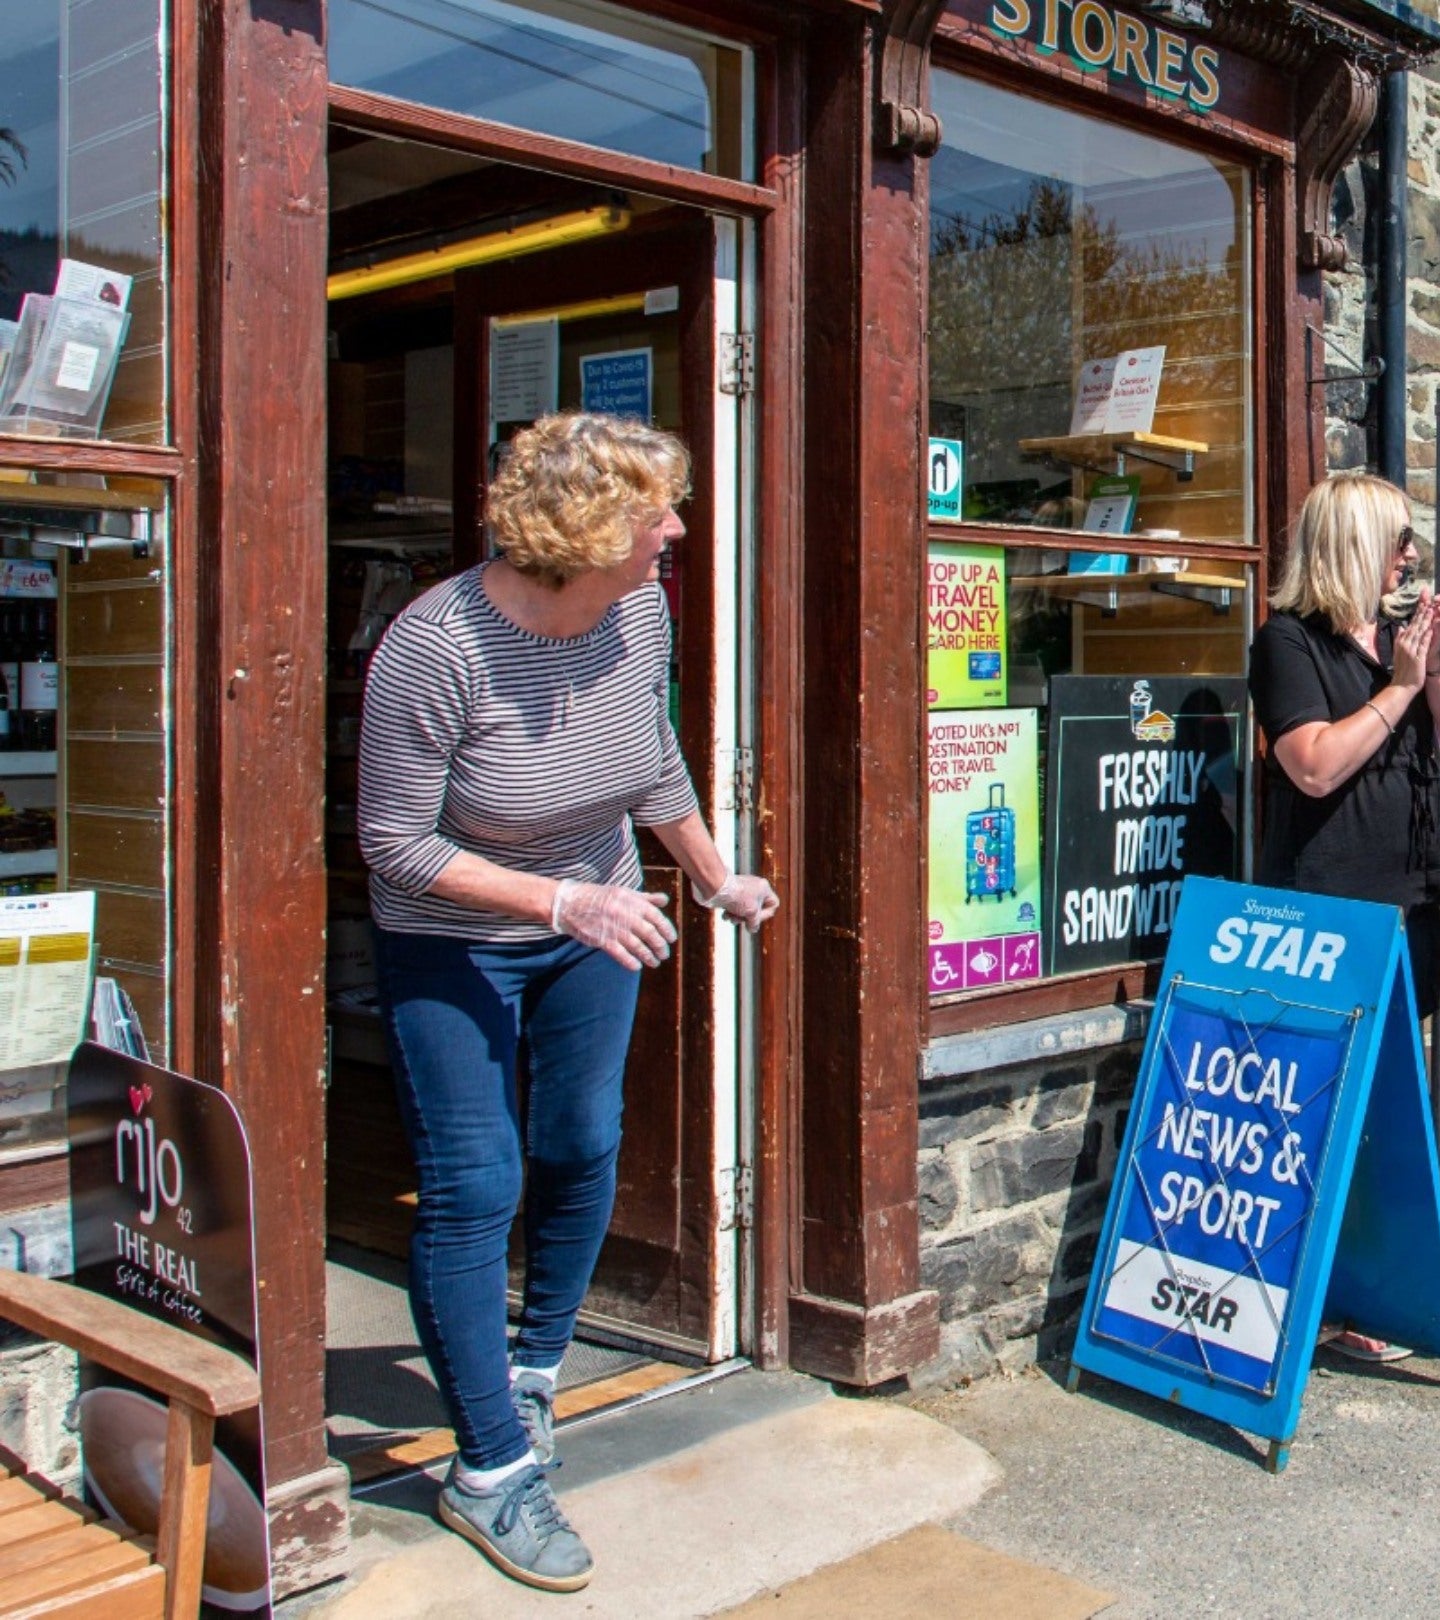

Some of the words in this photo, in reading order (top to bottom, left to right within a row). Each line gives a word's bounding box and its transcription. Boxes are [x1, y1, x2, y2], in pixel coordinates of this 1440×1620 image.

[991, 0, 1221, 107] STORES
[926, 584, 1000, 608] TRAVEL
[961, 564, 982, 584] UP
[986, 565, 1000, 584] A
[927, 609, 1000, 633] MONEY
[967, 634, 1001, 651] HERE
[950, 757, 997, 775] TRAVEL
[1099, 750, 1206, 812] FRESHLY
[1114, 814, 1187, 876] MADE
[1242, 899, 1306, 922] Shropshire
[1209, 916, 1347, 982] STAR
[1184, 1041, 1301, 1113] LOCAL
[1157, 1102, 1268, 1175] NEWS
[1271, 1131, 1306, 1186] &
[176, 1206, 194, 1235] 42
[1154, 1170, 1282, 1249] SPORT
[113, 1220, 150, 1270] THE
[153, 1241, 202, 1297] REAL
[1151, 1276, 1239, 1333] STAR
